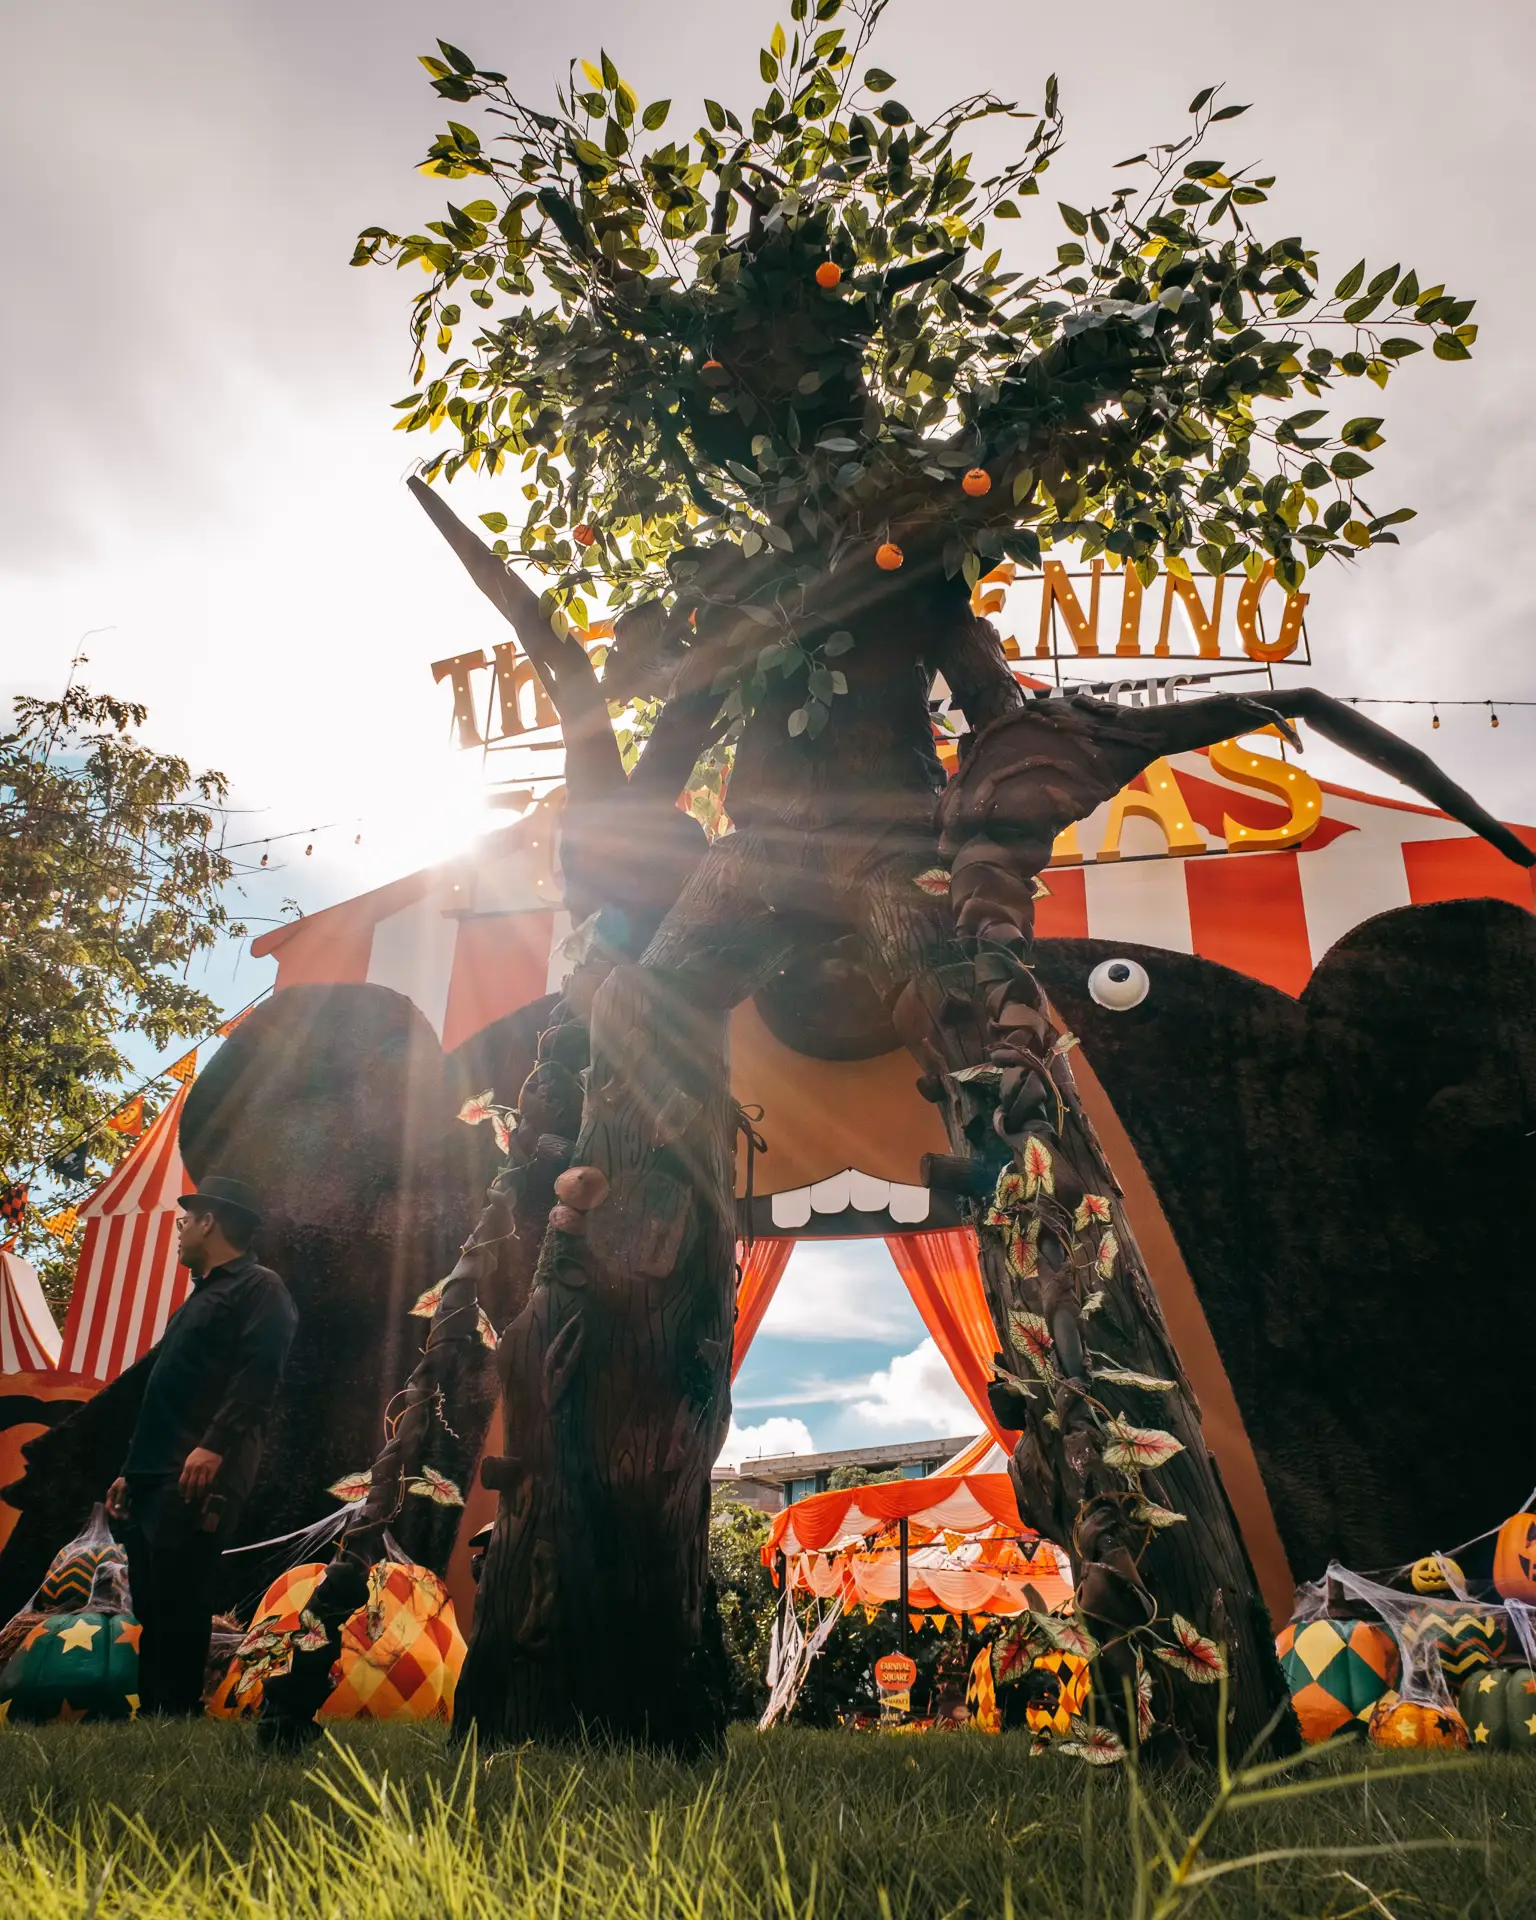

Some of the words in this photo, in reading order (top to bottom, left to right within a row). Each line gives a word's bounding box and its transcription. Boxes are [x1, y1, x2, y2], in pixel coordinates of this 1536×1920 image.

[1022, 674, 1193, 708] GIC
[880, 1662, 911, 1671] CARNIVAL
[881, 1673, 909, 1681] SQUARE
[880, 1713, 900, 1721] GAME
